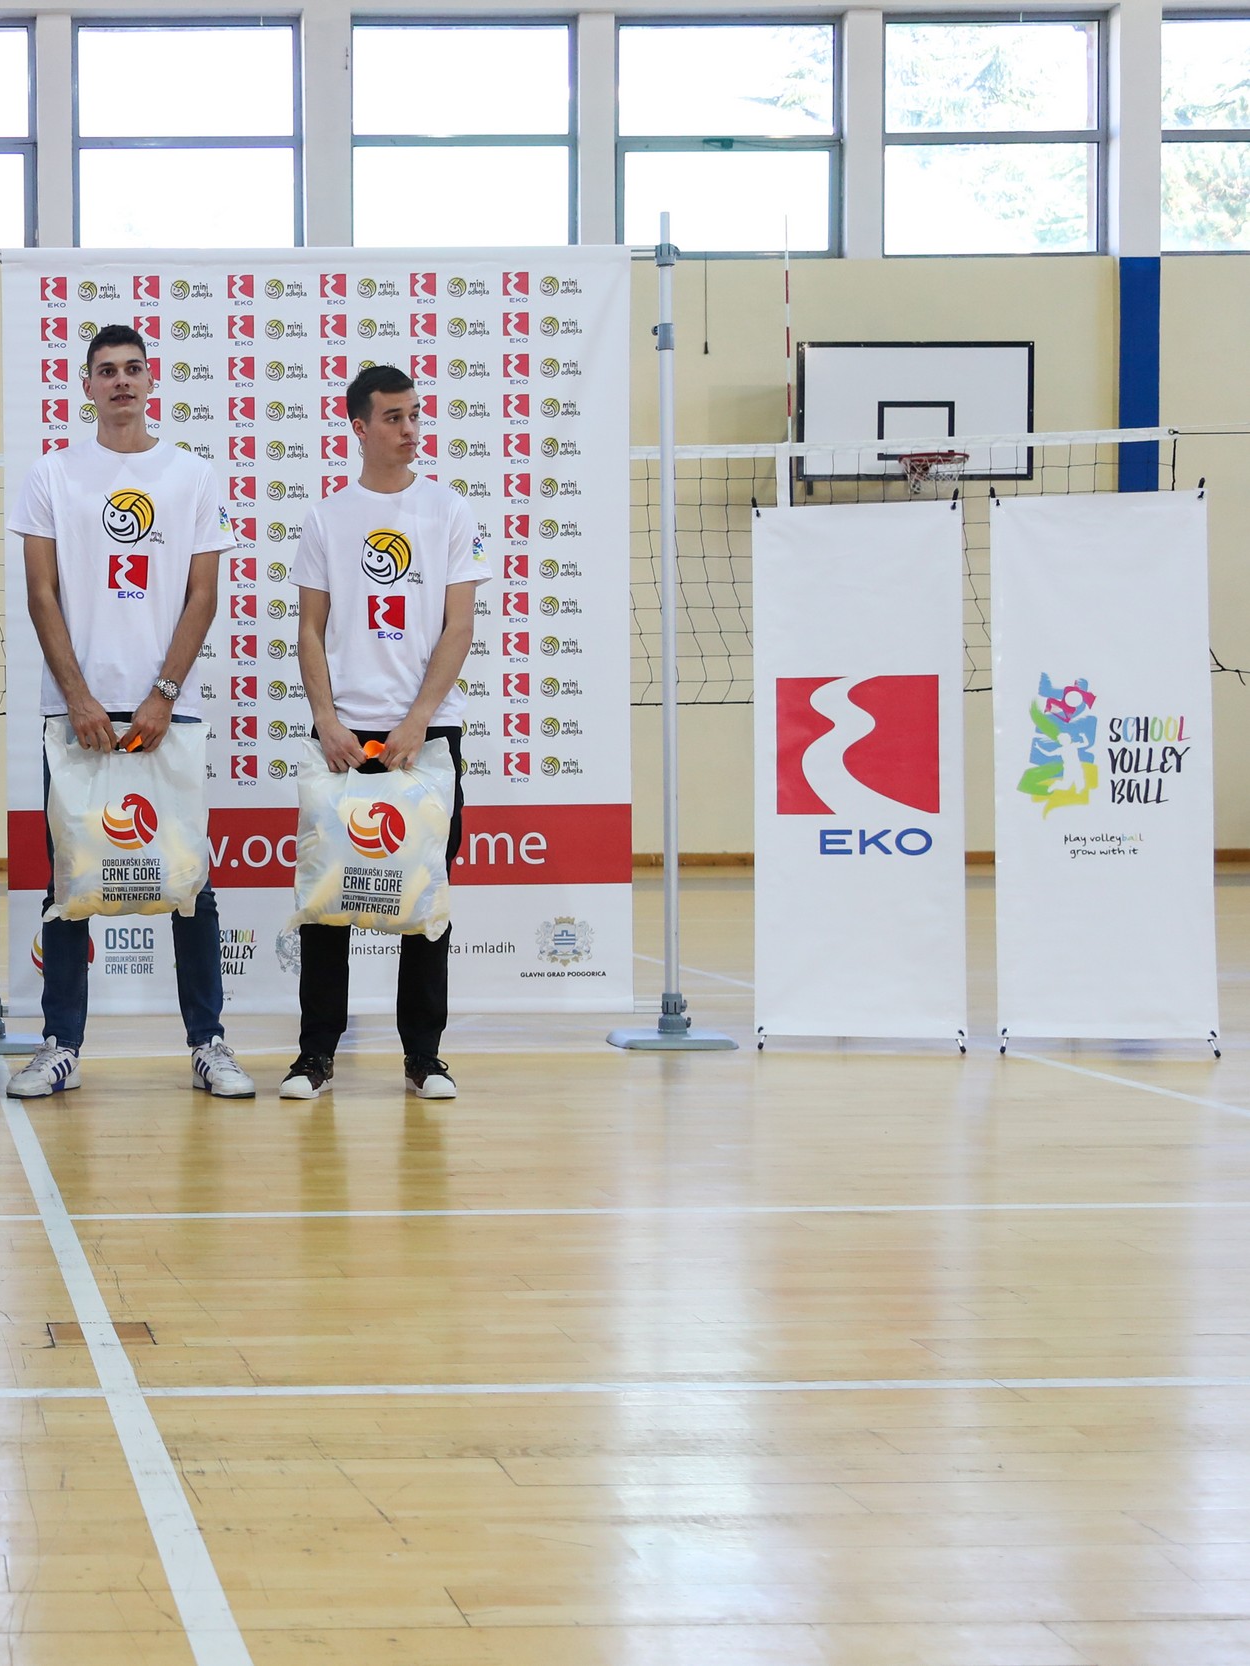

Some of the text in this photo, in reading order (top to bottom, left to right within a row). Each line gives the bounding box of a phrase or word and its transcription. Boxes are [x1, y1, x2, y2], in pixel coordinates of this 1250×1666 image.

[117, 591, 145, 600] EKO
[377, 631, 403, 640] EKO
[1109, 716, 1191, 742] SCHOOL
[1108, 746, 1191, 774] VOLLEY
[1110, 778, 1169, 804] BALL
[819, 828, 933, 855] EKO
[1064, 833, 1087, 845] play
[1070, 846, 1139, 859] grow with it
[102, 867, 161, 881] CRNE GORE
[343, 875, 403, 893] CRNE GORE
[102, 893, 161, 902] MONTENEGRO
[341, 901, 400, 916] MONTENEGRO
[105, 928, 154, 950] OSCG
[219, 929, 257, 943] SCHOOL
[472, 942, 516, 954] mladih
[105, 963, 154, 974] CRNE GORE
